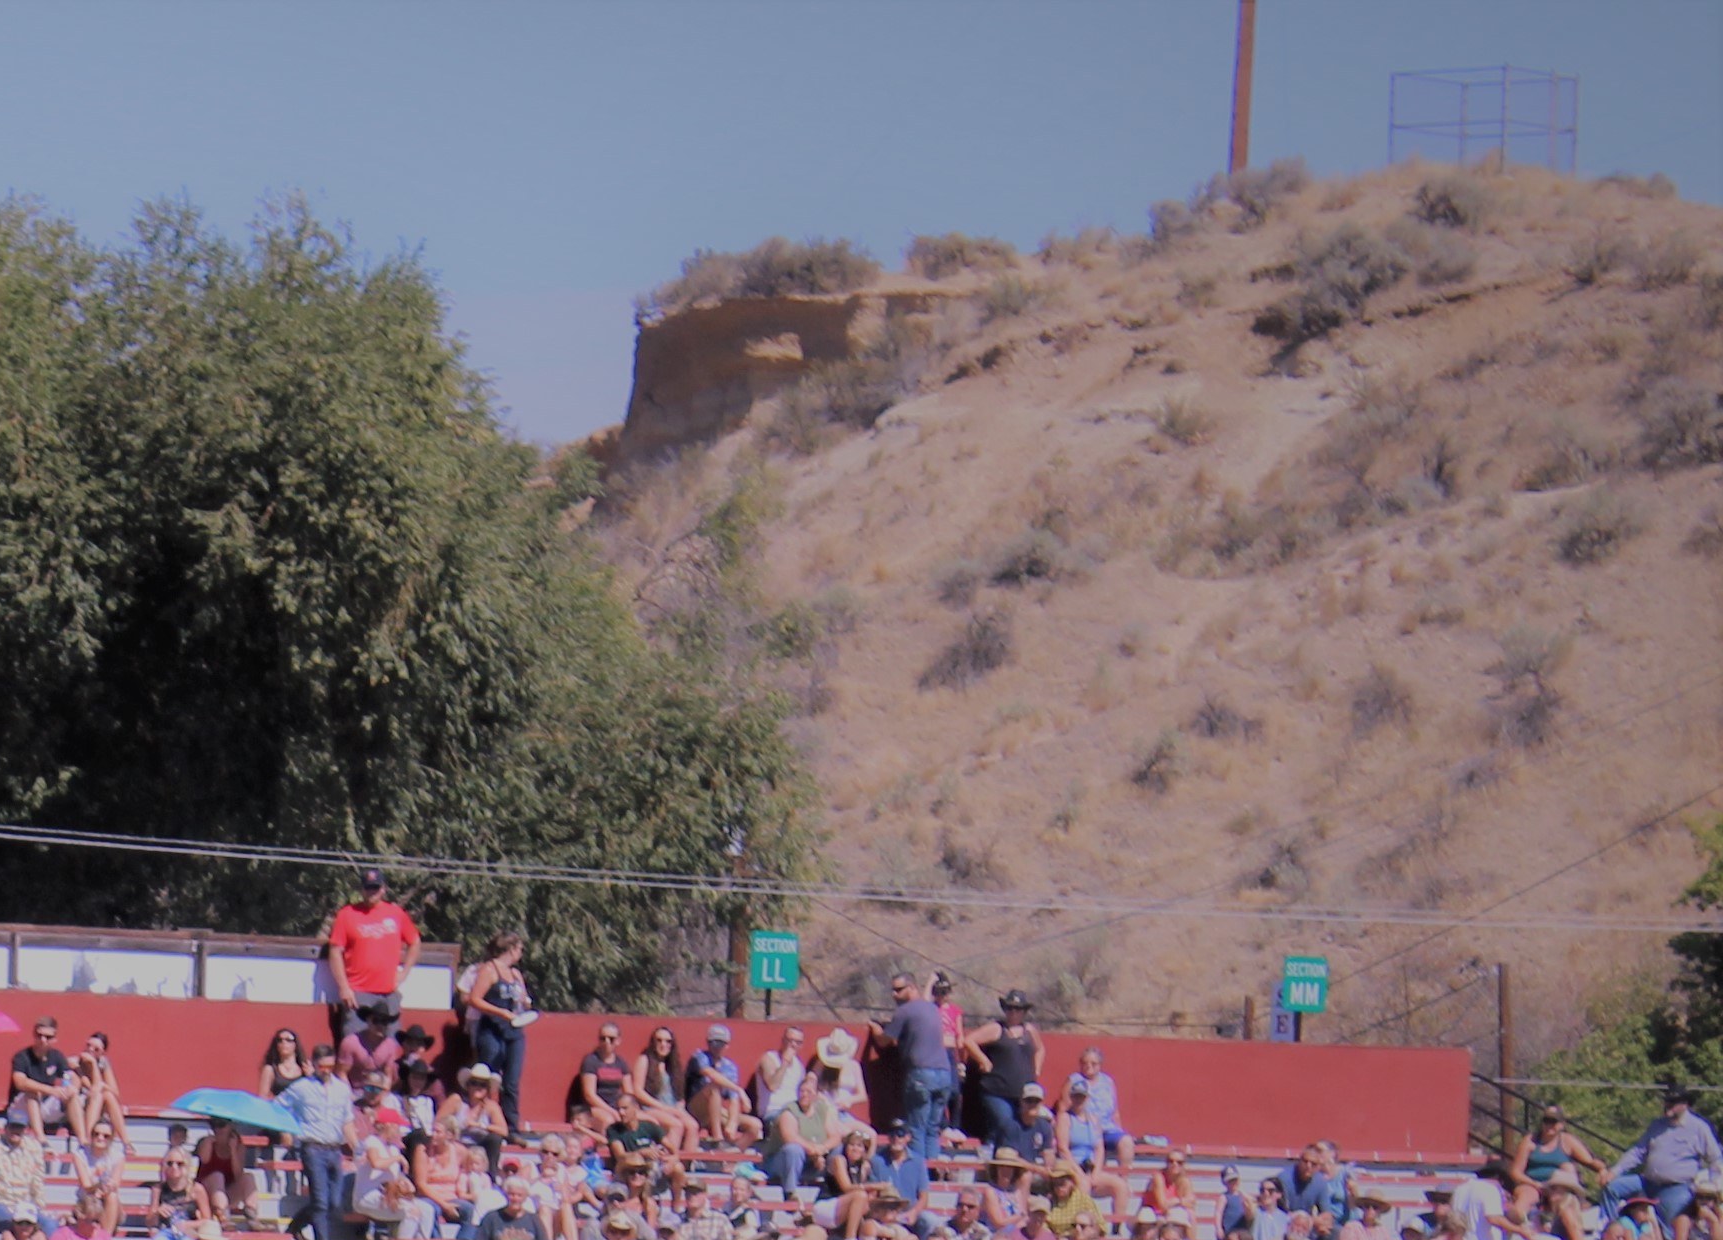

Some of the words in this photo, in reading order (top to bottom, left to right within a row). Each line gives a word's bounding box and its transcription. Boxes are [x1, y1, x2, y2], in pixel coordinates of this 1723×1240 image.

[754, 938, 798, 953] SECTION
[762, 957, 786, 982] LL
[1286, 962, 1327, 977] SECTION
[1290, 981, 1320, 1005] MM
